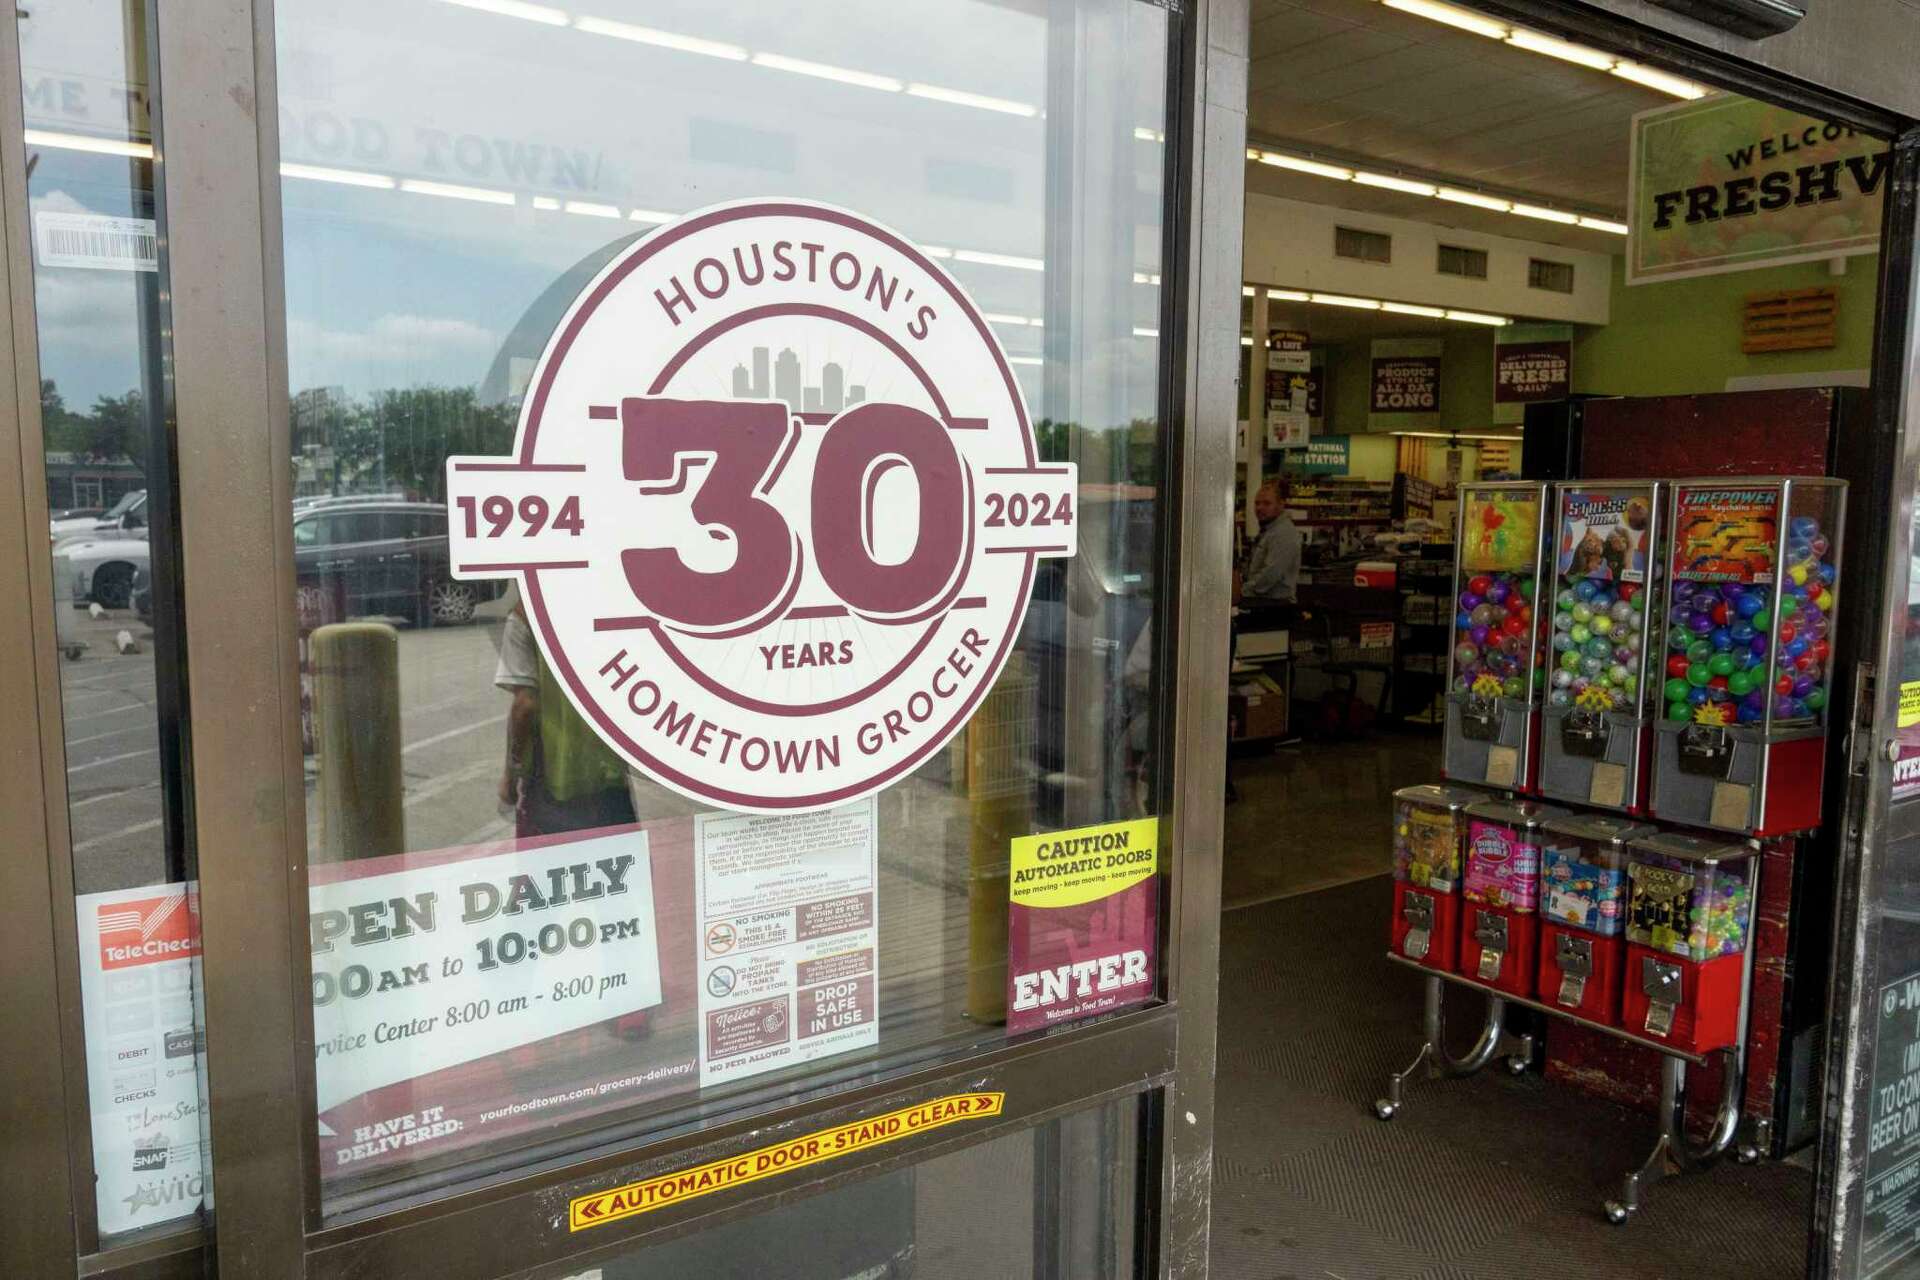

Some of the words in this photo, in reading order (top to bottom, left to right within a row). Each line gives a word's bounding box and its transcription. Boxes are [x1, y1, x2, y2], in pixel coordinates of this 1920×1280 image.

[1726, 120, 1858, 171] WELCO
[653, 240, 938, 342] HOUSTON'S
[1377, 367, 1435, 378] PRODUCE
[1499, 360, 1567, 371] DELIVERED
[1499, 369, 1567, 385] FRESH
[1376, 384, 1403, 394] ALL
[1407, 383, 1434, 393] DAY
[1376, 393, 1434, 408] LONG
[1516, 384, 1549, 393] DAILY
[984, 493, 1074, 528] 2024
[1683, 491, 1777, 505] FIREPOWER
[1711, 504, 1750, 512] Keychains
[456, 494, 586, 539] 1994
[621, 396, 976, 640] 30
[759, 639, 854, 672] YEARS
[598, 648, 842, 775] HOMETOWN
[856, 626, 990, 757] GROCER
[1036, 831, 1130, 862] CAUTION
[1013, 886, 1032, 897] keep
[1032, 882, 1059, 893] moving
[1064, 877, 1081, 888] keep
[1081, 873, 1106, 884] moving
[1111, 870, 1127, 881] keep
[1128, 866, 1153, 877] moving
[1014, 857, 1101, 884] AUTOMATIC
[1106, 848, 1153, 867] DOORS
[310, 891, 438, 955] PEN
[460, 853, 636, 925] DAILY
[736, 917, 749, 926] NO
[751, 910, 791, 923] SMOKING
[441, 955, 464, 979] to
[1013, 949, 1149, 1011] ENTER
[814, 982, 858, 1002] DROP
[816, 996, 857, 1018] SAFE
[1046, 1004, 1074, 1019] Welcome
[1082, 1000, 1097, 1013] Food
[1098, 995, 1116, 1009] Town!
[374, 1015, 439, 1045] Center
[445, 999, 490, 1028] 8:00
[497, 994, 529, 1015] am
[552, 973, 594, 1003] 8:00
[598, 971, 628, 1001] pm
[810, 1018, 828, 1034] IN
[832, 1009, 863, 1028] USE
[117, 1047, 150, 1061] DEBIT
[709, 1064, 723, 1073] NO
[749, 1047, 791, 1064] ALLOWED
[114, 1088, 157, 1104] CHECKS
[480, 1059, 697, 1124] yourfoodtown.com/grocery-delivery/
[1880, 1083, 1895, 1117] TO
[354, 1112, 416, 1144] HAVE
[421, 1105, 444, 1127] IT
[1870, 1111, 1901, 1153] BEER
[336, 1119, 464, 1166] DELIVERED:
[608, 1161, 749, 1214] AUTOMATIC
[756, 1139, 819, 1172] DOOR
[834, 1116, 901, 1149] STAND
[906, 1098, 971, 1128] CLEAR
[133, 1151, 168, 1169] SNAP
